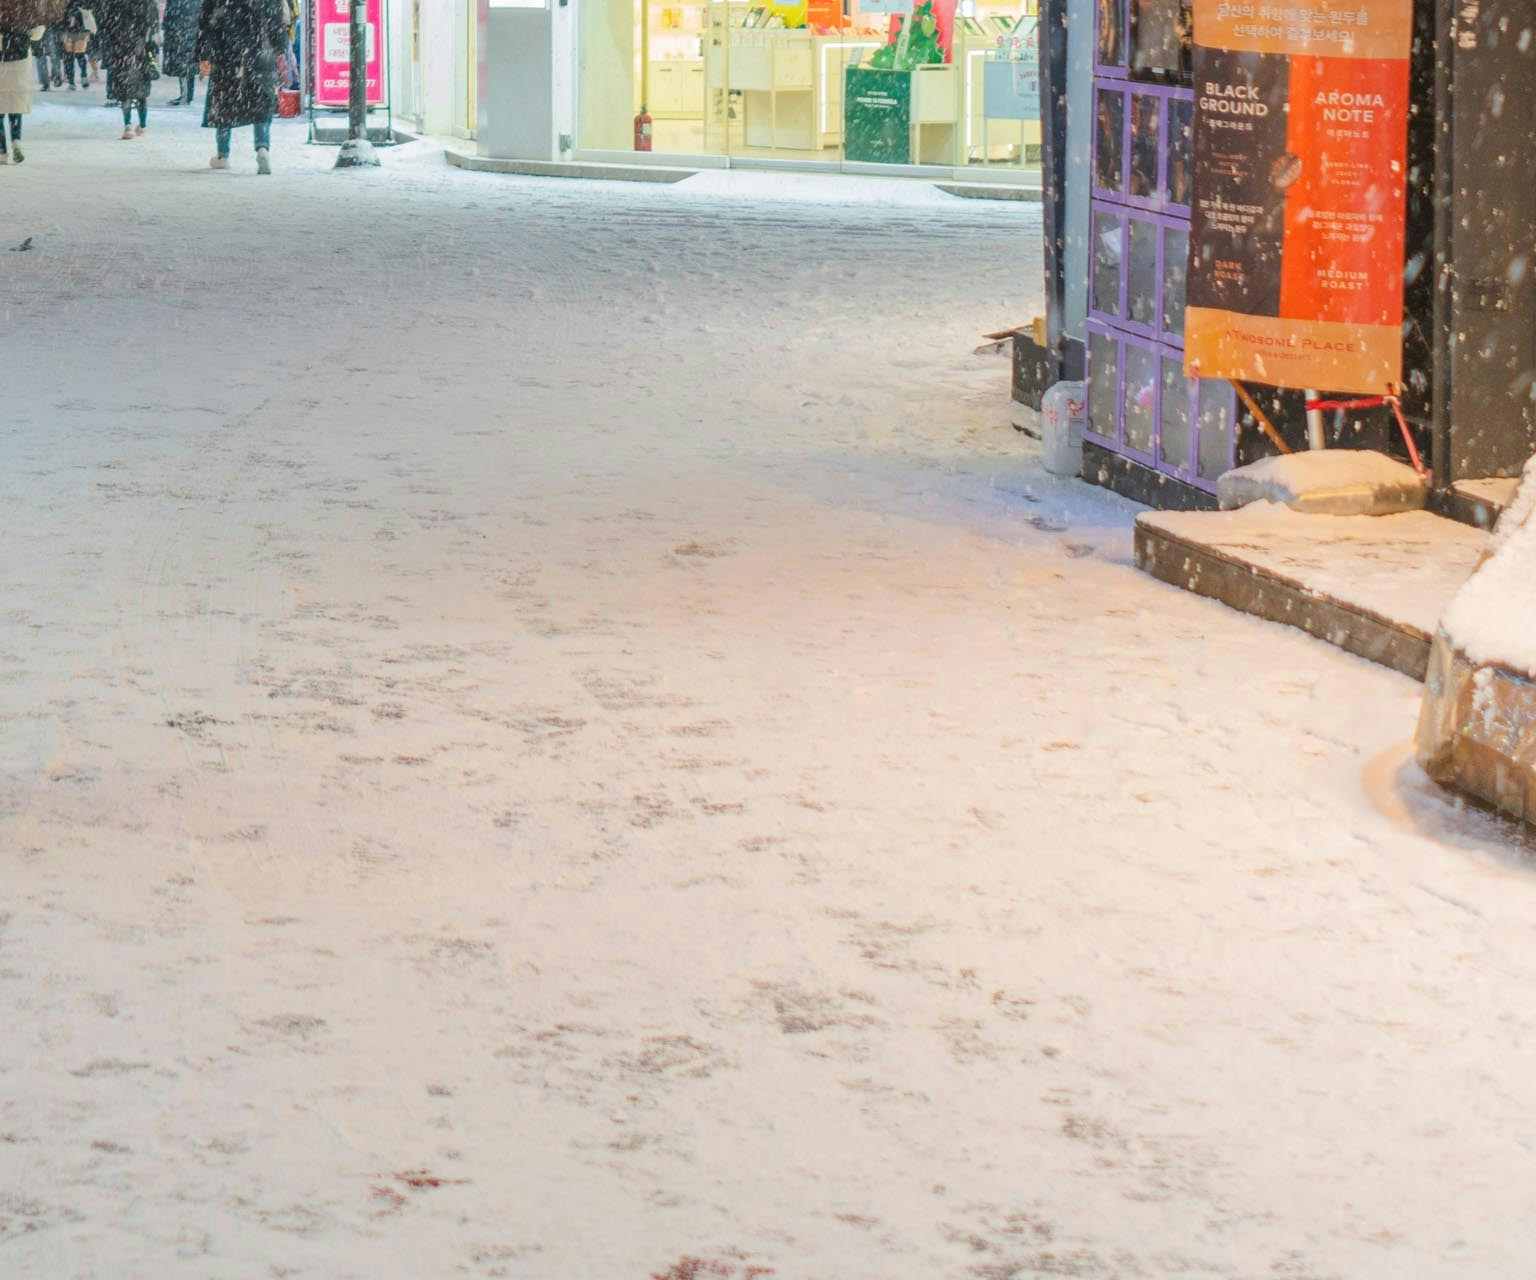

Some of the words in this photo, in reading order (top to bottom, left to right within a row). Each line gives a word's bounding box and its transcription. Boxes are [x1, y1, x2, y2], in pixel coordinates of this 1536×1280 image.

[1205, 81, 1260, 100] BLACK
[1315, 90, 1385, 107] AROMA
[1199, 96, 1269, 117] GROUND
[1323, 108, 1375, 124] NOTE
[1316, 268, 1369, 280] MEDIUM
[1301, 338, 1356, 354] PLACE
